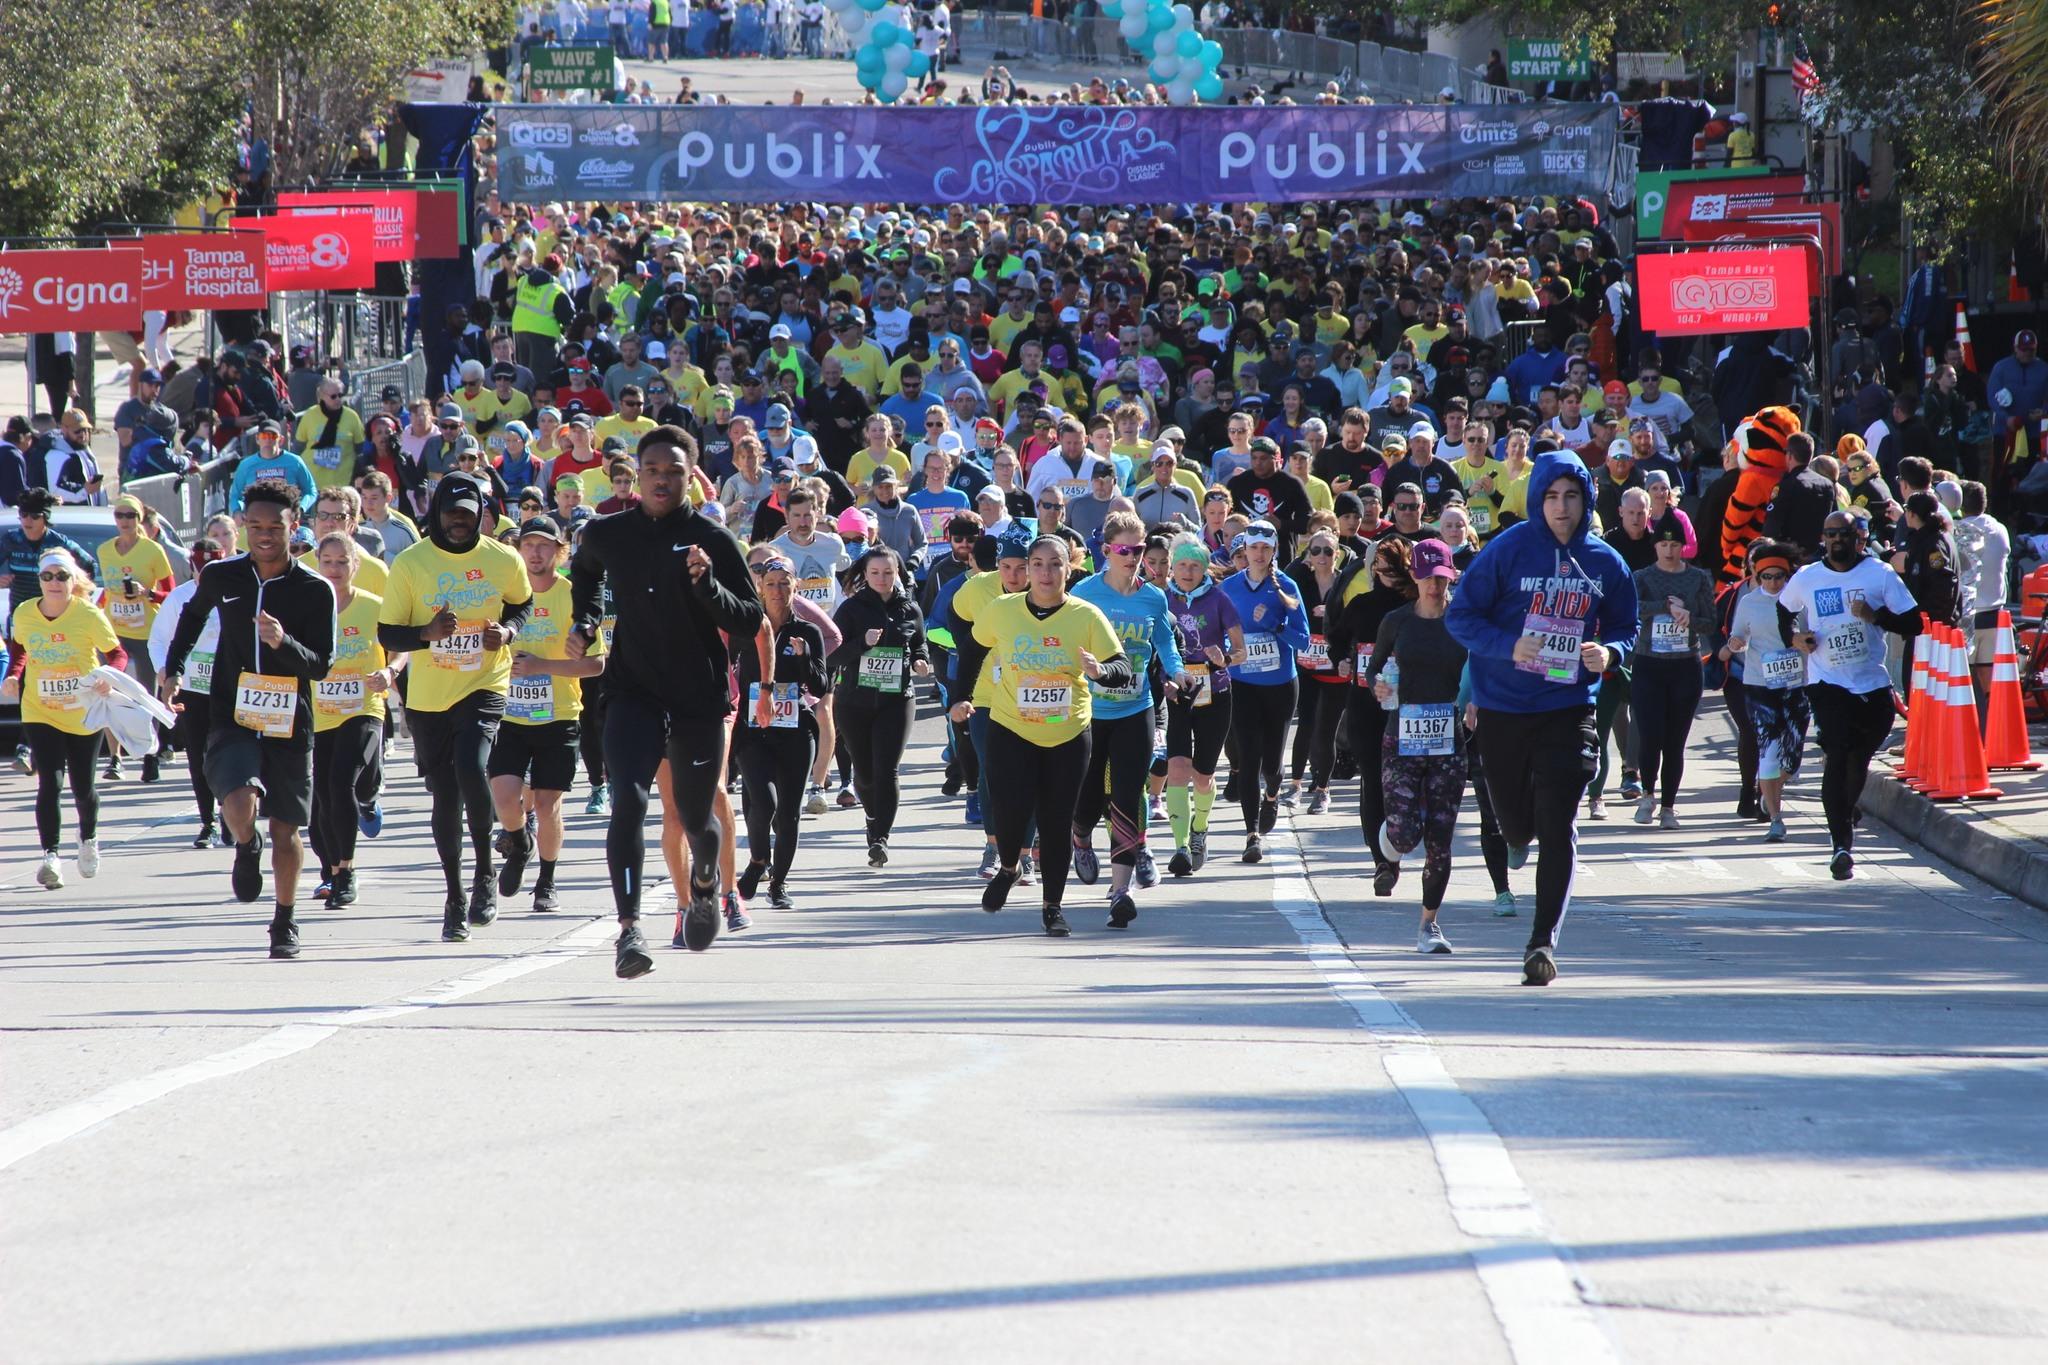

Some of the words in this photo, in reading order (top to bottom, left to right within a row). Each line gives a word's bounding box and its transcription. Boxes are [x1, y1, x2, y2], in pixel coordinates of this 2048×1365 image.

[1528, 43, 1571, 58] WAV
[551, 51, 596, 66] WAVE
[1511, 61, 1562, 75] START
[533, 70, 585, 84] START
[590, 70, 611, 84] #1
[513, 120, 569, 146] Q105
[1460, 123, 1518, 144] Times
[1553, 125, 1592, 139] Cigna
[1024, 140, 1057, 153] Publix
[678, 131, 883, 179] Publix
[1219, 132, 1426, 179] Publix
[1495, 154, 1520, 162] Tampa
[1543, 154, 1586, 169] DICK'S
[1127, 162, 1165, 175] DISTANCE
[1494, 167, 1526, 176] Hospital
[525, 176, 554, 186] USAA
[1128, 171, 1161, 183] CLASSIC
[375, 223, 403, 235] CLASSIC
[266, 243, 306, 255] News
[184, 248, 245, 265] Tampa
[142, 259, 174, 280] GH
[185, 264, 254, 279] General
[1704, 265, 1741, 276] Tampa
[1744, 264, 1775, 275] Bay's
[32, 277, 128, 312] Cigna
[185, 279, 259, 298] Hospital
[1677, 276, 1773, 314] Q105
[1677, 313, 1702, 324] 104.7
[1722, 313, 1769, 324] WRBQ-FM
[1520, 577, 1544, 592] WE
[1545, 578, 1585, 594] CAME
[1588, 579, 1604, 594] TO
[1817, 597, 1841, 607] YORK
[1818, 590, 1838, 600] NEW
[113, 603, 141, 614] 11834
[1820, 604, 1840, 614] LIFE
[455, 626, 481, 634] Publix
[1551, 624, 1580, 636] Publix
[1827, 631, 1865, 650] 18753
[867, 659, 895, 671] 9277
[1766, 658, 1799, 674] 10456
[42, 678, 80, 692] 11632
[264, 682, 294, 690] Publix
[319, 681, 359, 695] 12743
[508, 685, 548, 699] 10994
[243, 689, 290, 708] 12731
[1023, 688, 1067, 703] 12557
[1423, 709, 1451, 717] Publix
[1405, 718, 1449, 734] 11367
